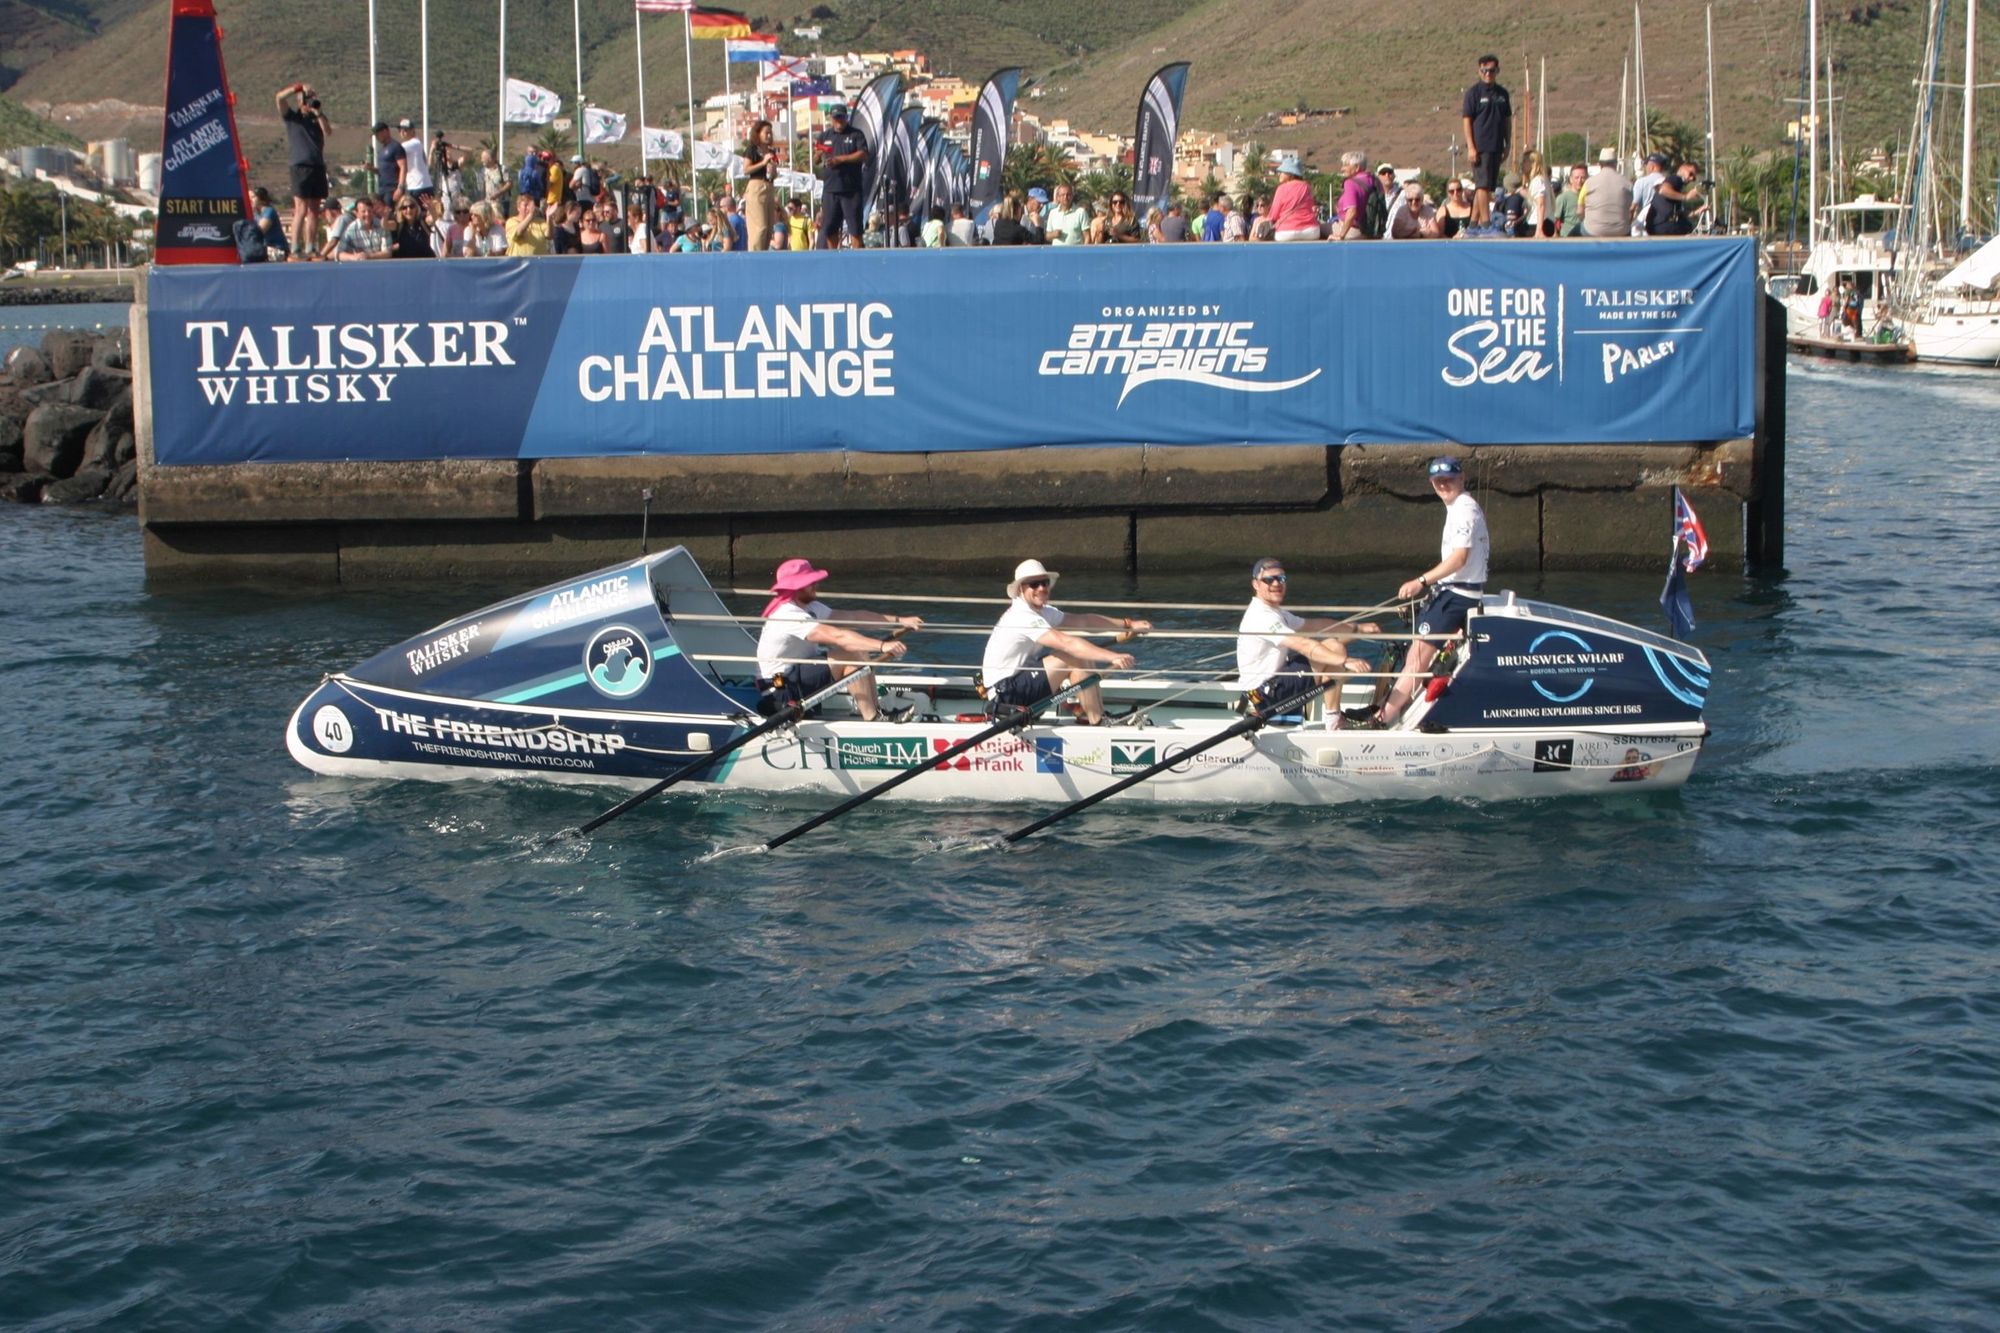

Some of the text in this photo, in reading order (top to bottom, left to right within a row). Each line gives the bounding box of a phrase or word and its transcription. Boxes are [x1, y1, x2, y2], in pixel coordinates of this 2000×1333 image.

[168, 88, 222, 123] TALISKER
[165, 125, 228, 172] CHALLENGE
[172, 118, 222, 154] ATLANTIC
[166, 200, 238, 214] START LINE
[1102, 304, 1220, 317] ORGANIZED BY
[1448, 288, 1546, 316] ONE FOR
[1580, 288, 1695, 306] TALISKER
[638, 302, 894, 353] ATLANTIC
[1600, 310, 1677, 320] MADE BY THE SEA
[185, 320, 516, 372] TALISKER
[1501, 318, 1546, 346] THE
[1441, 320, 1554, 387] Sea
[1602, 340, 1674, 384] PARLEY
[198, 373, 398, 406] WHISKY
[578, 350, 895, 402] CHALLENGE
[550, 575, 629, 609] ATLANTIC
[533, 588, 630, 628] CHALLENGE
[406, 624, 480, 666] TALISKER
[411, 640, 470, 676] WHISKY
[1497, 652, 1624, 667] BRUNSWICK WHARF
[1577, 666, 1596, 674] DEVON
[1483, 708, 1540, 718] LAUNCHING
[1541, 706, 1594, 716] EXPLORERS
[1594, 706, 1622, 715] SINCE
[325, 721, 343, 741] 40
[376, 708, 626, 756] THE FRIENDSHIP
[412, 741, 594, 769] THEFRIENDSHIPATLANTIC.COM
[761, 736, 836, 770] CH
[842, 742, 881, 754] Church
[844, 755, 879, 765] House
[883, 742, 923, 765] IM
[974, 738, 1033, 756] Knight
[975, 758, 1024, 772] Frank
